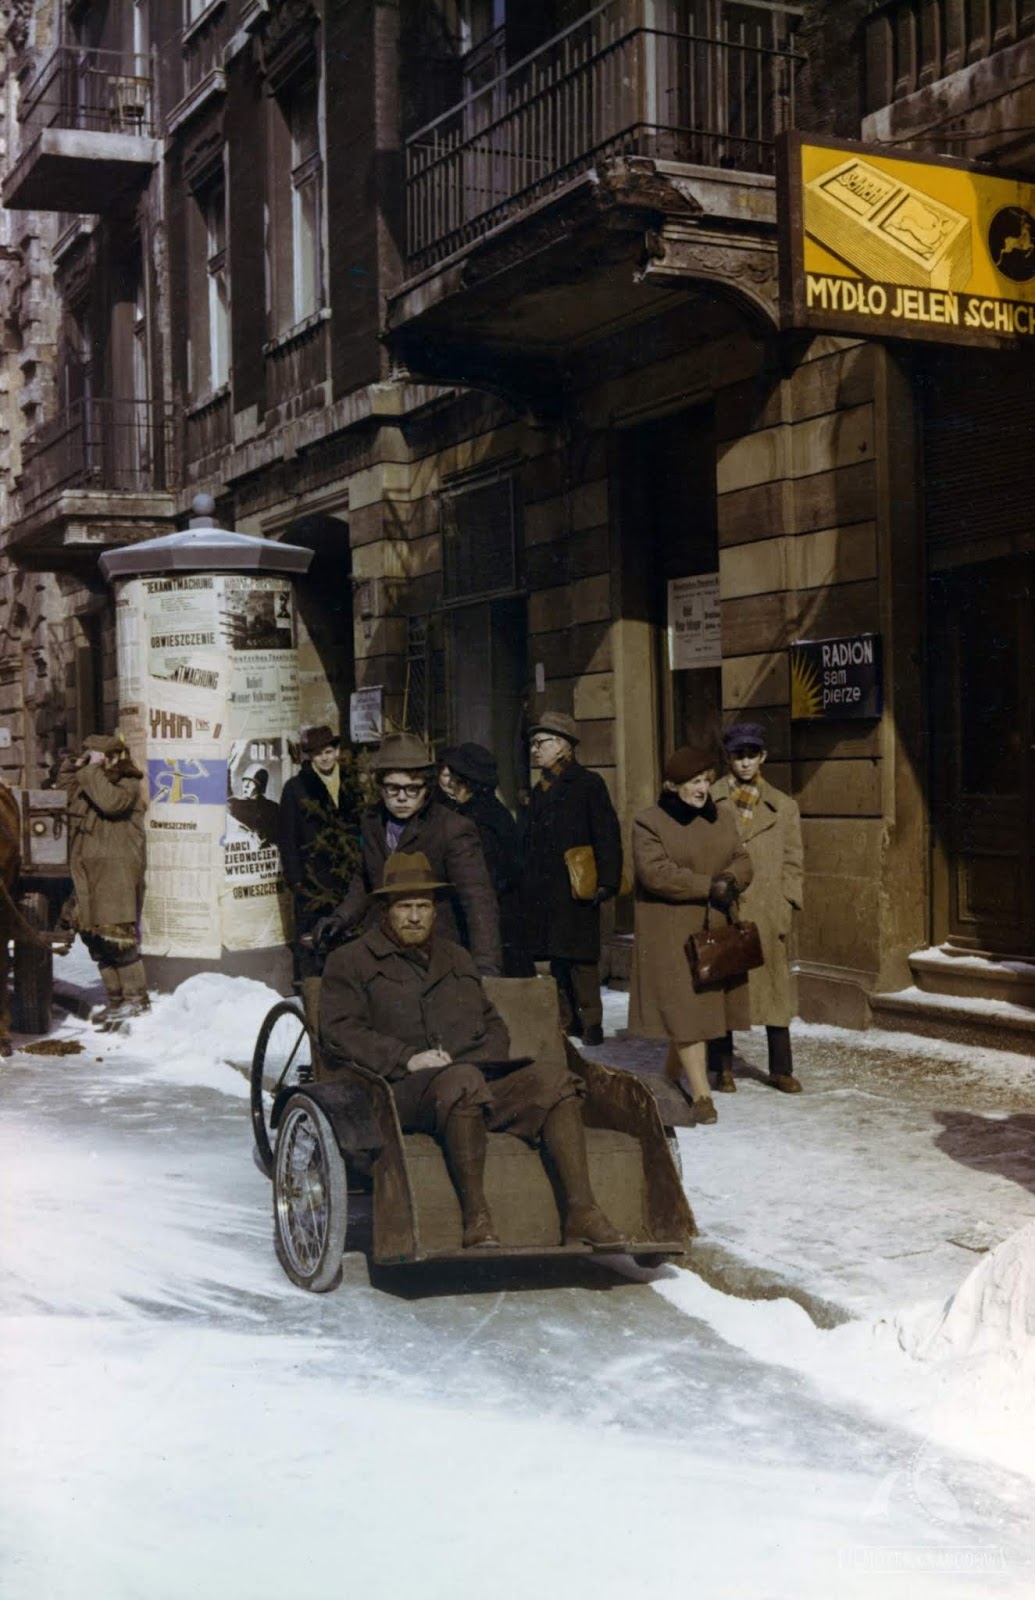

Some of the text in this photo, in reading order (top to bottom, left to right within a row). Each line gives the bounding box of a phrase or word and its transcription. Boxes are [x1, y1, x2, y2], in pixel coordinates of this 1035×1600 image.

[807, 274, 887, 315] MYDŁO
[150, 631, 216, 649] OBWIESZCZENIE
[822, 640, 873, 667] RADION
[823, 669, 847, 686] sam
[823, 686, 861, 709] pierze
[150, 819, 197, 831] Obwieszczenie
